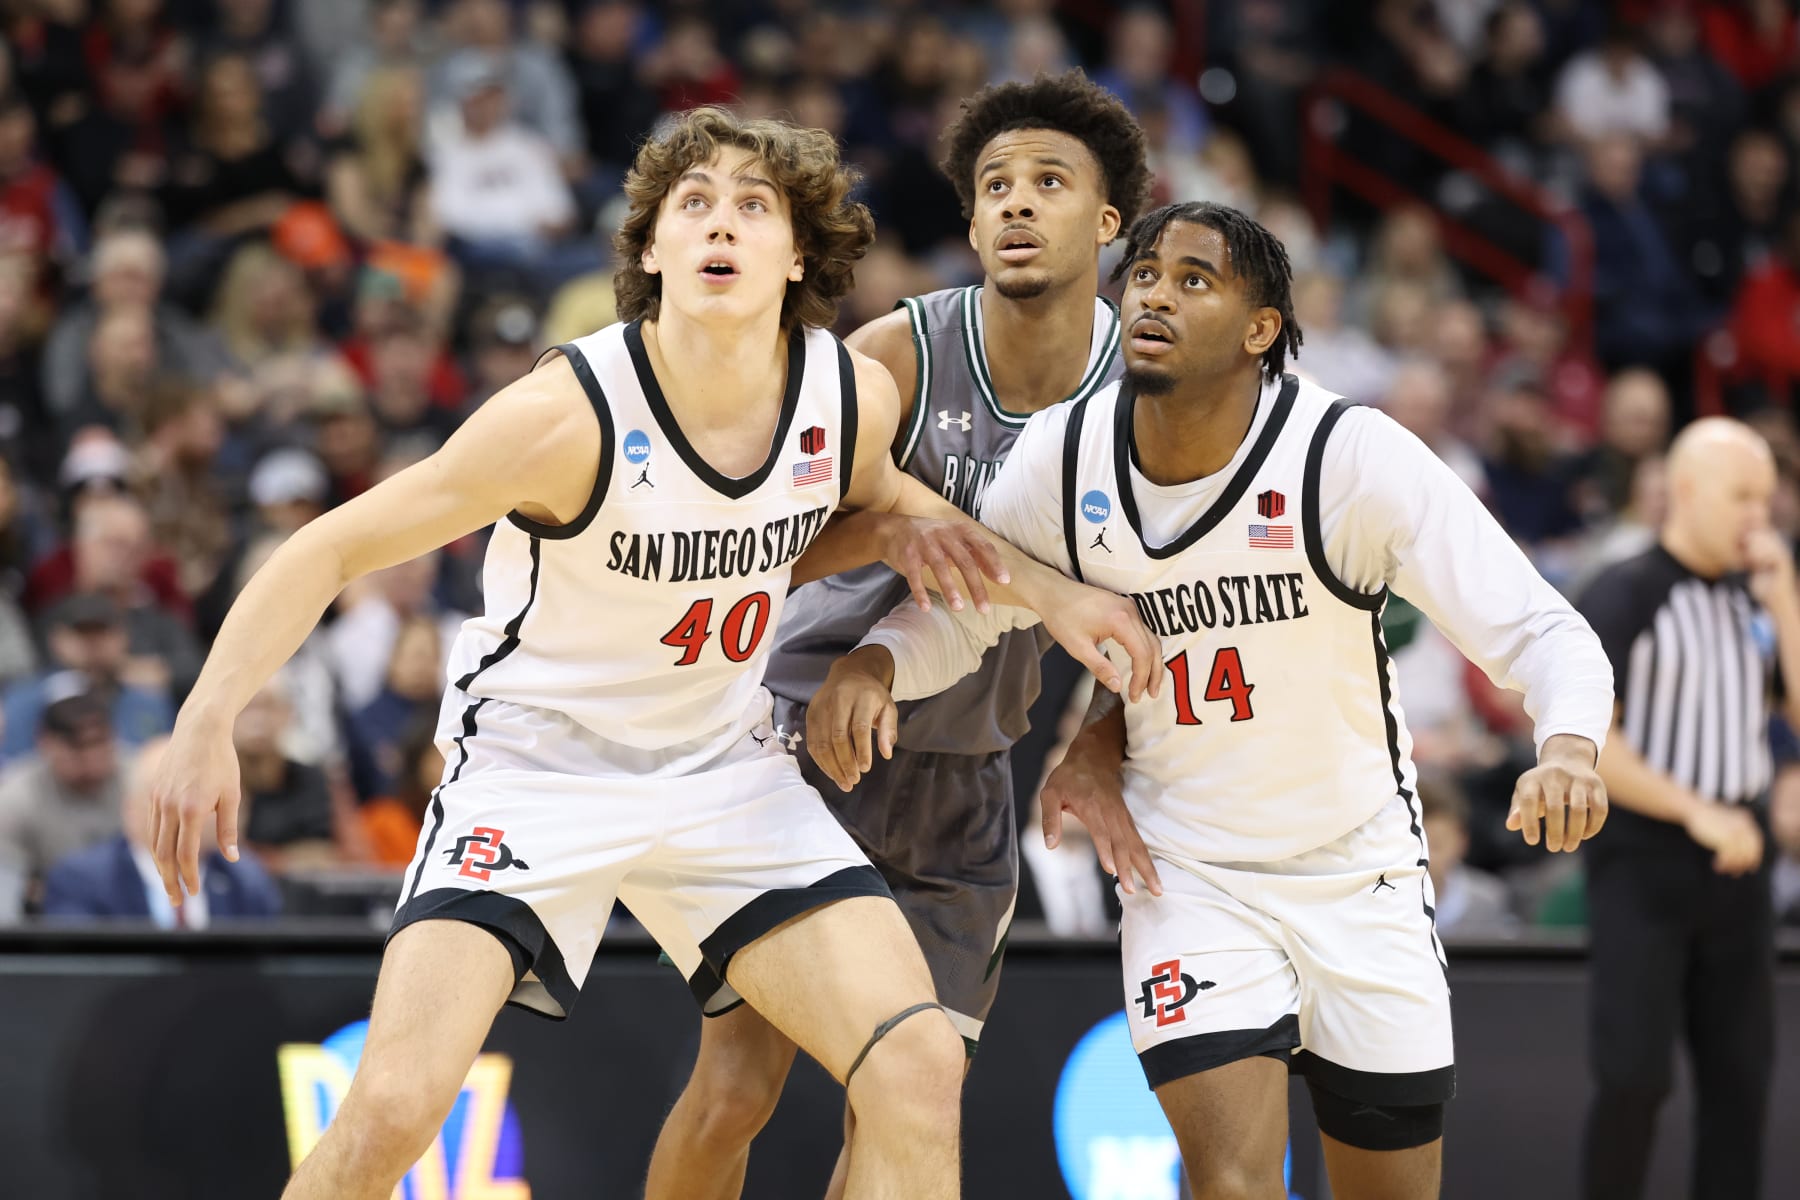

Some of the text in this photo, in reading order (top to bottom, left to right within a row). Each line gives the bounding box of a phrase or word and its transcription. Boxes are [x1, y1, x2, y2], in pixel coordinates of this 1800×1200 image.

[627, 445, 649, 456] NCAA
[1084, 503, 1108, 518] NCAA
[606, 530, 665, 582] SAN
[668, 527, 756, 582] DIEGO
[1217, 572, 1309, 628] STATE
[660, 591, 771, 666] 40
[1164, 646, 1255, 725] 14
